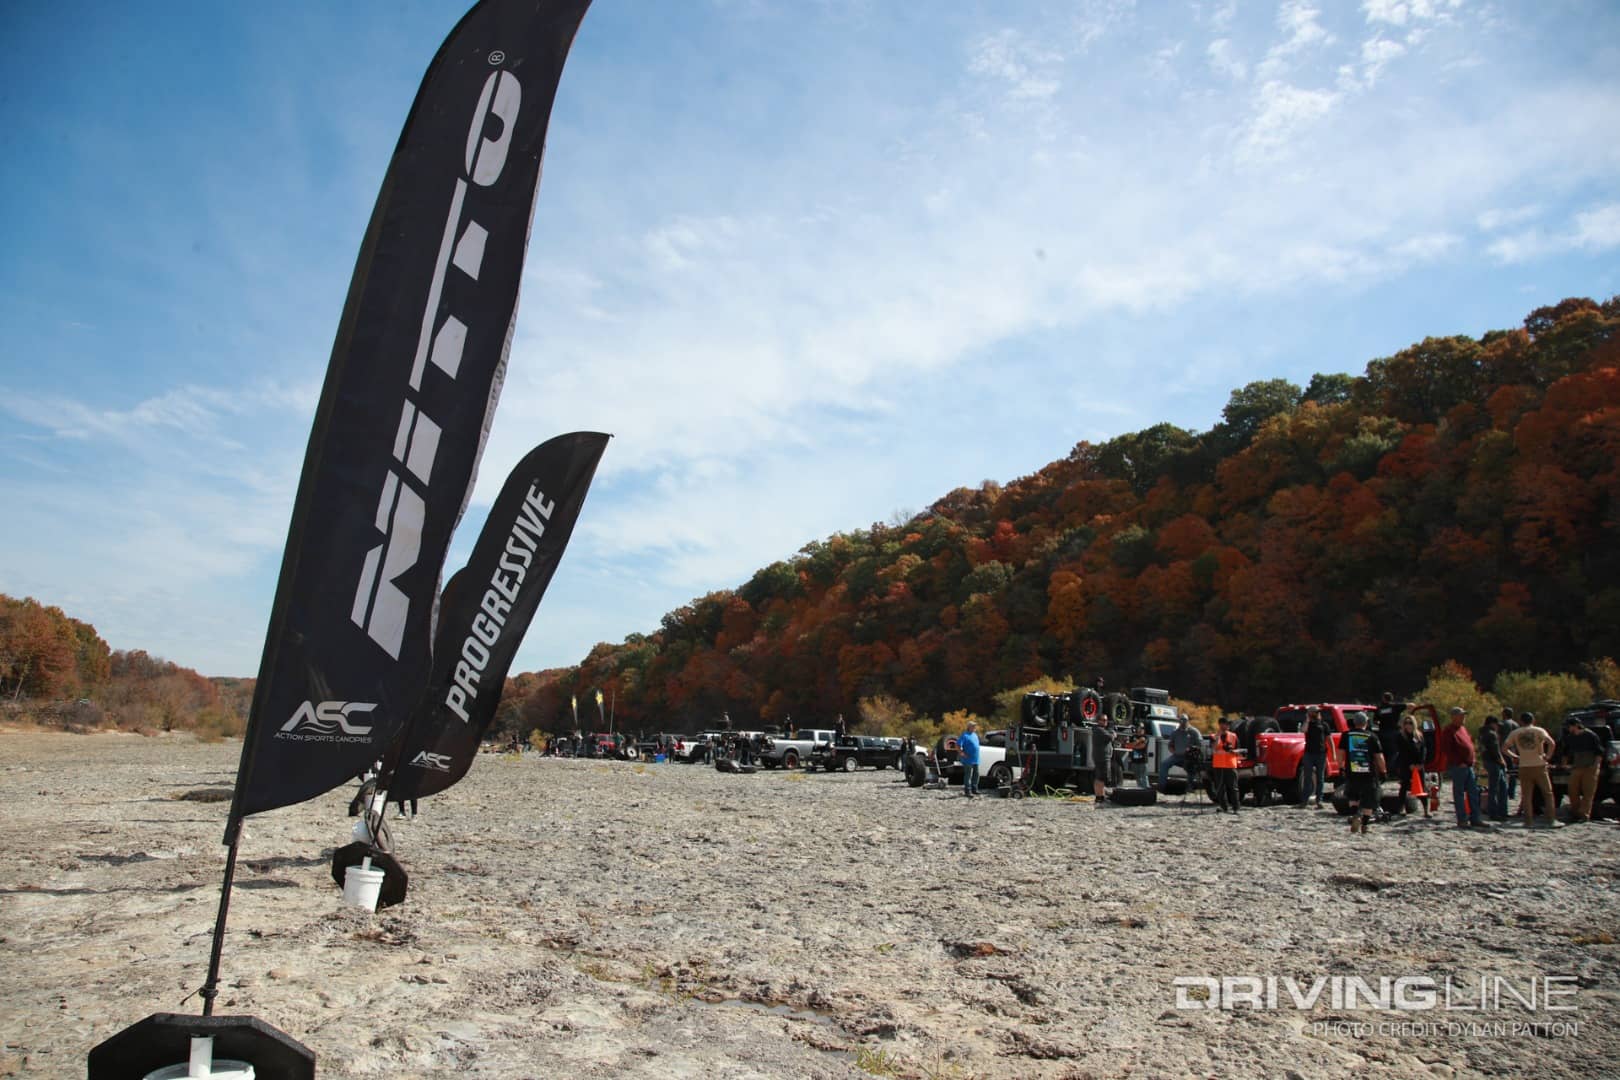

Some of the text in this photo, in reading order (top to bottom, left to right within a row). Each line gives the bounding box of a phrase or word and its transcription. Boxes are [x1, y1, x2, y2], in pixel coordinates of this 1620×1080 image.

[350, 69, 521, 661] NITTO
[445, 484, 555, 723] PROGRESSIVE
[280, 700, 378, 735] ASC
[273, 732, 303, 741] ACTION
[335, 736, 372, 744] CANOPIES
[412, 750, 453, 769] ASC
